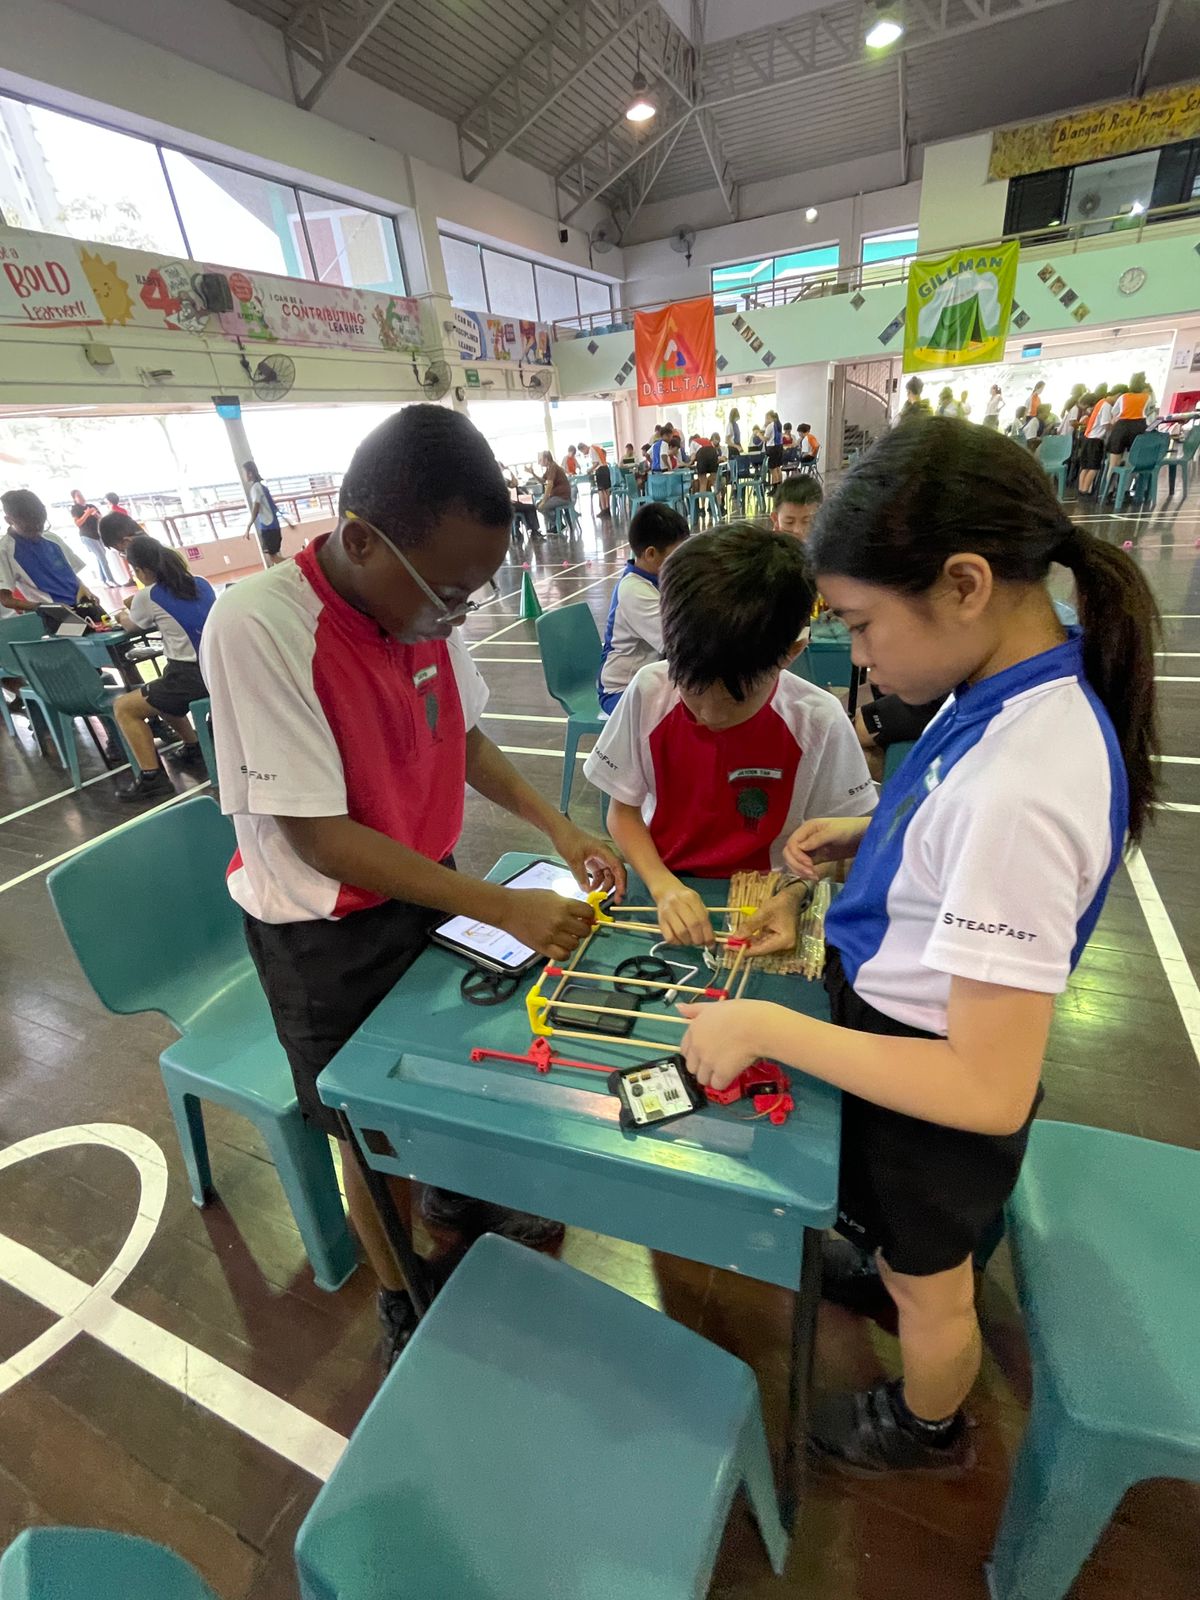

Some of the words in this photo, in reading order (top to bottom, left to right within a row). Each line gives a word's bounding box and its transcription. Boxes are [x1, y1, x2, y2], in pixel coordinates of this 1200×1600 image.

[1057, 114, 1106, 144] Blangah
[1108, 113, 1134, 131] Rise
[3, 261, 71, 299] BOLD
[918, 256, 1003, 298] GILLMAN
[275, 294, 289, 303] CAN
[282, 303, 366, 325] CONTRIBUTING
[329, 322, 366, 335] LEARNER
[643, 375, 710, 396] D.E.L.T.A.
[943, 912, 1038, 942] STEADFAST
